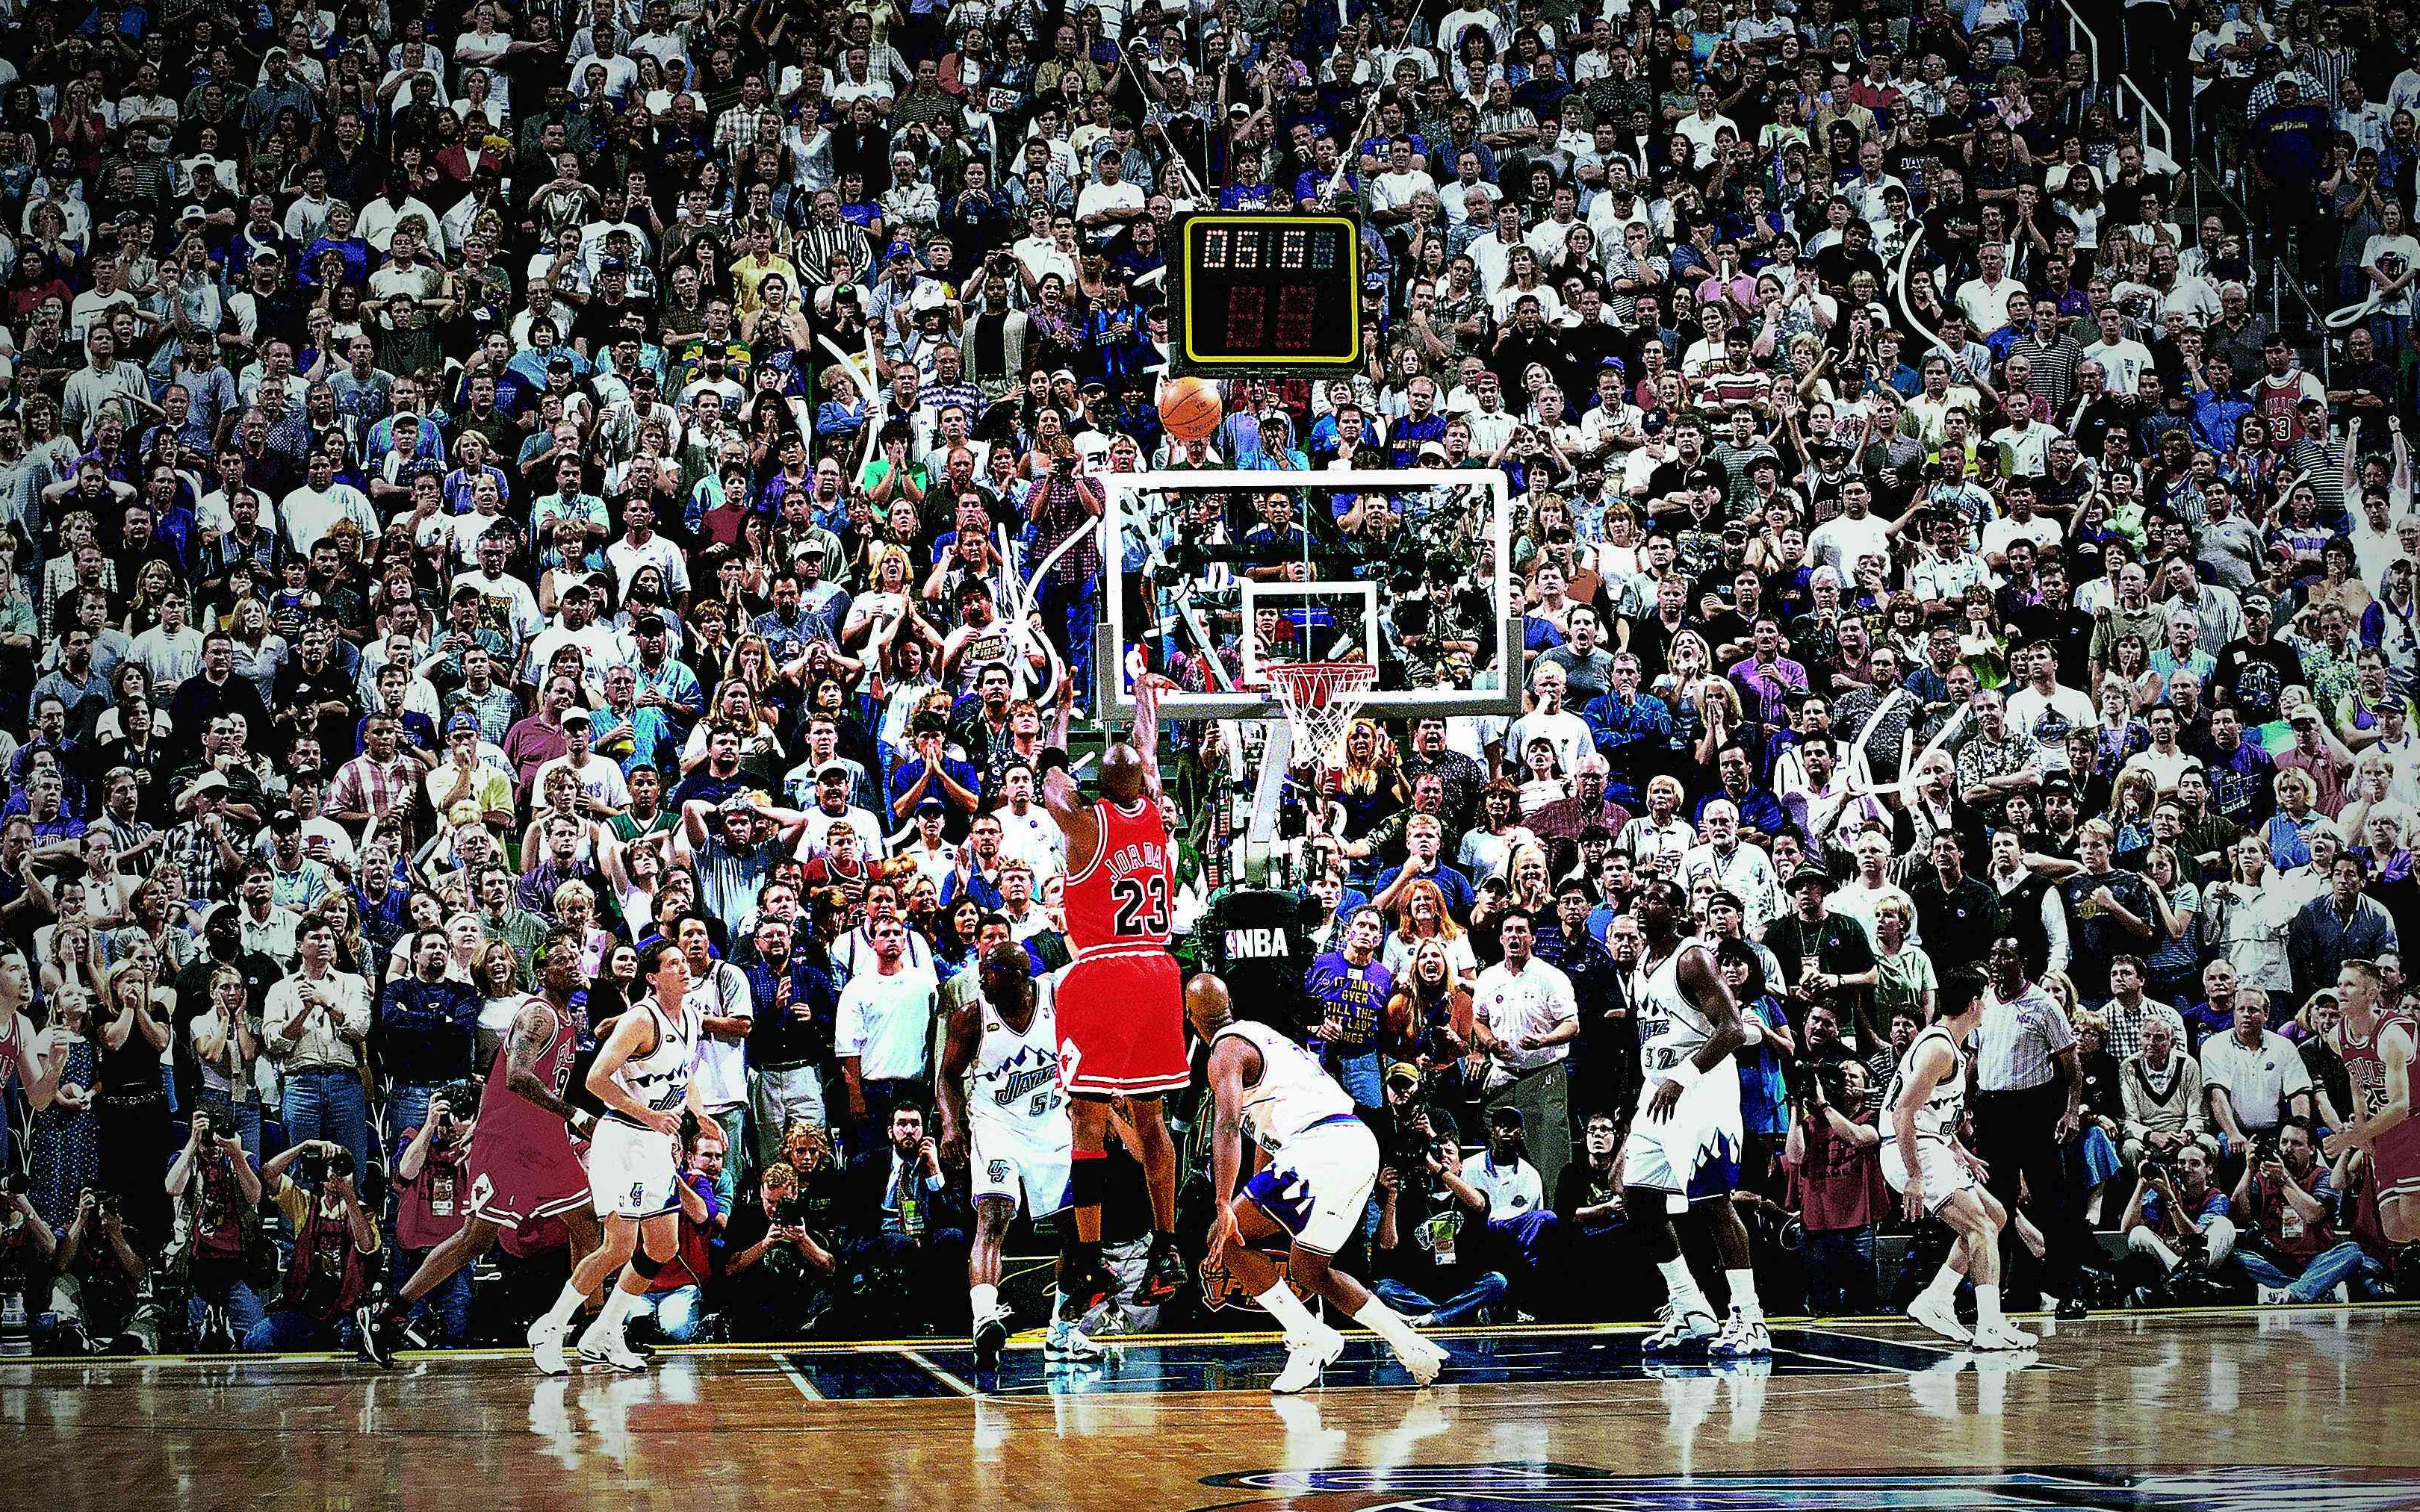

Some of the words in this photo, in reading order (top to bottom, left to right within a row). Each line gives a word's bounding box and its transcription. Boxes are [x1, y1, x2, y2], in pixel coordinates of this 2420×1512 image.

[1104, 841, 1166, 883] JORDA
[1111, 874, 1173, 937] 23
[1235, 928, 1289, 959] NBA
[1333, 976, 1344, 987] IT
[1341, 989, 1368, 1004] OVER
[1327, 1001, 1351, 1015] TILL
[1356, 1006, 1375, 1020] THE
[1347, 1017, 1371, 1031] LADY
[1645, 1046, 1679, 1071] 32
